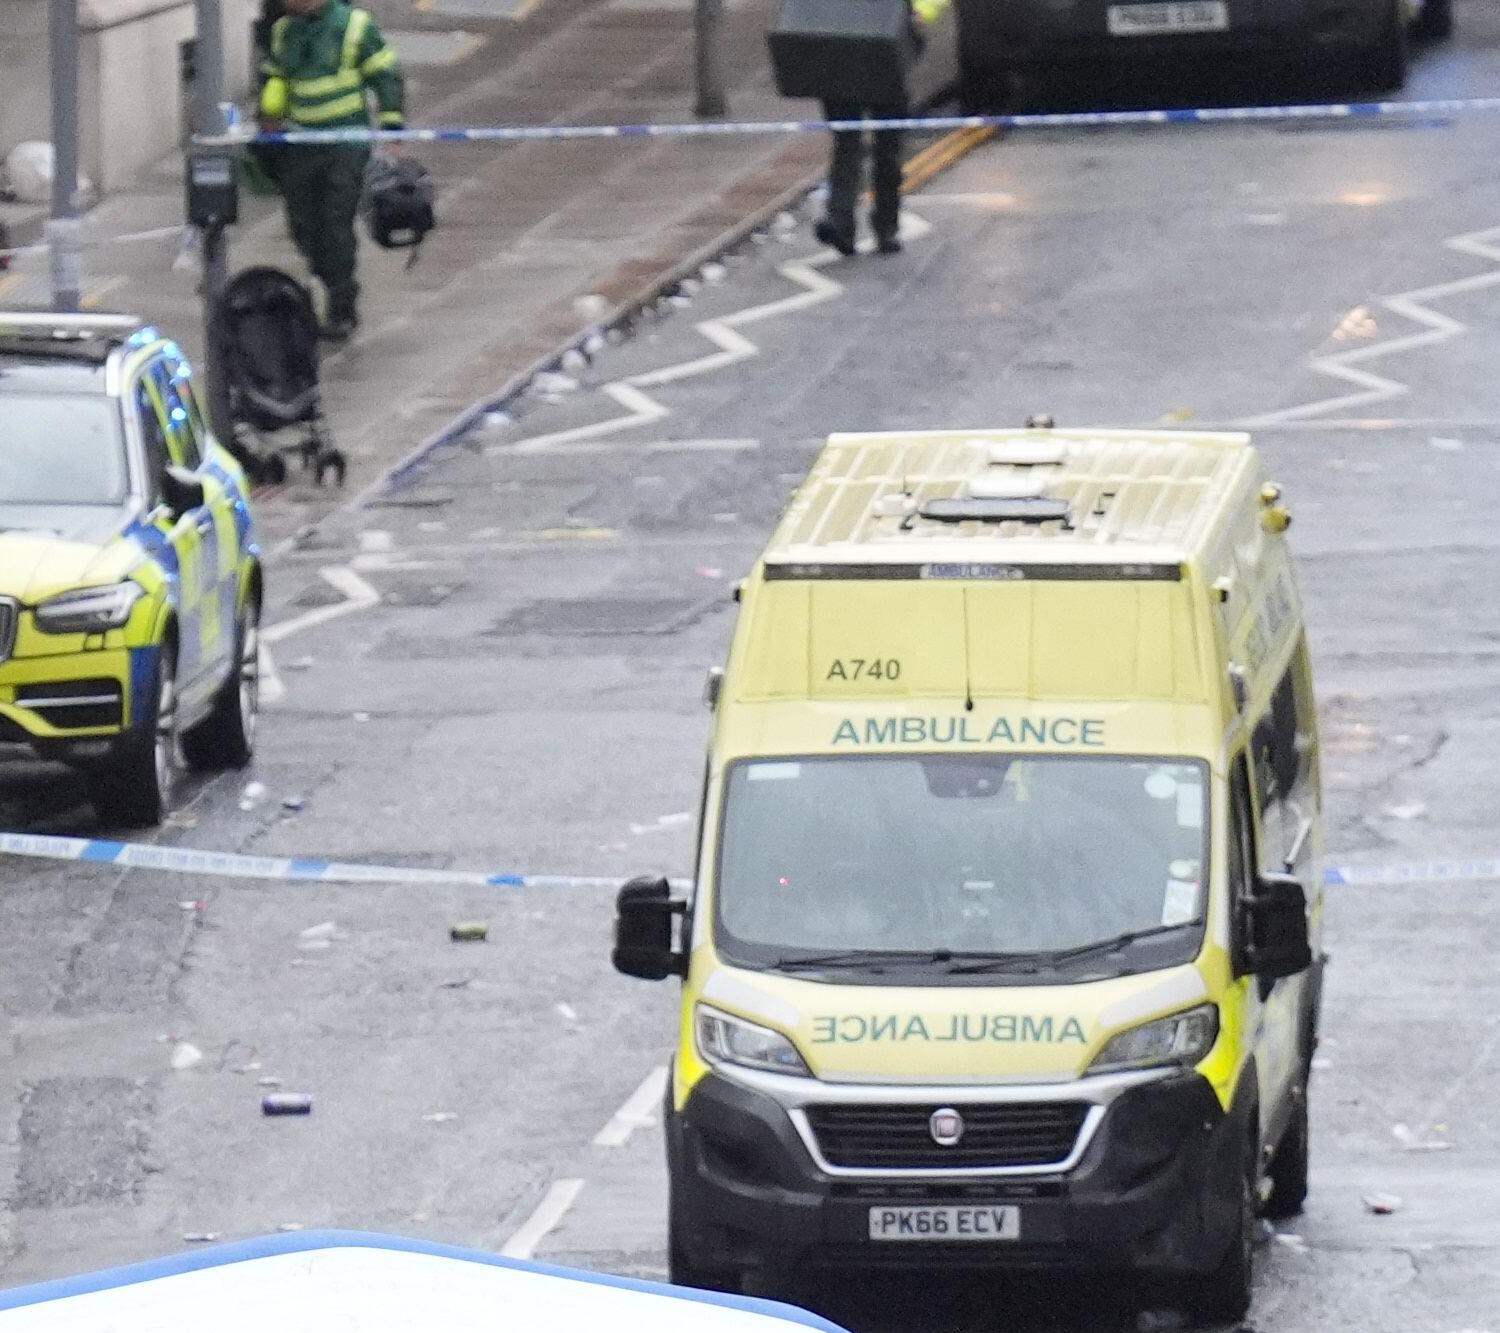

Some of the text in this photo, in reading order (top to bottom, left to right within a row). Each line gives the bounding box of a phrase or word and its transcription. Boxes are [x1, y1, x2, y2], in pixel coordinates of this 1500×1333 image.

[826, 658, 901, 681] A740
[831, 717, 1106, 747] AMBULANCE
[881, 1210, 1007, 1233] PK66 ECV
